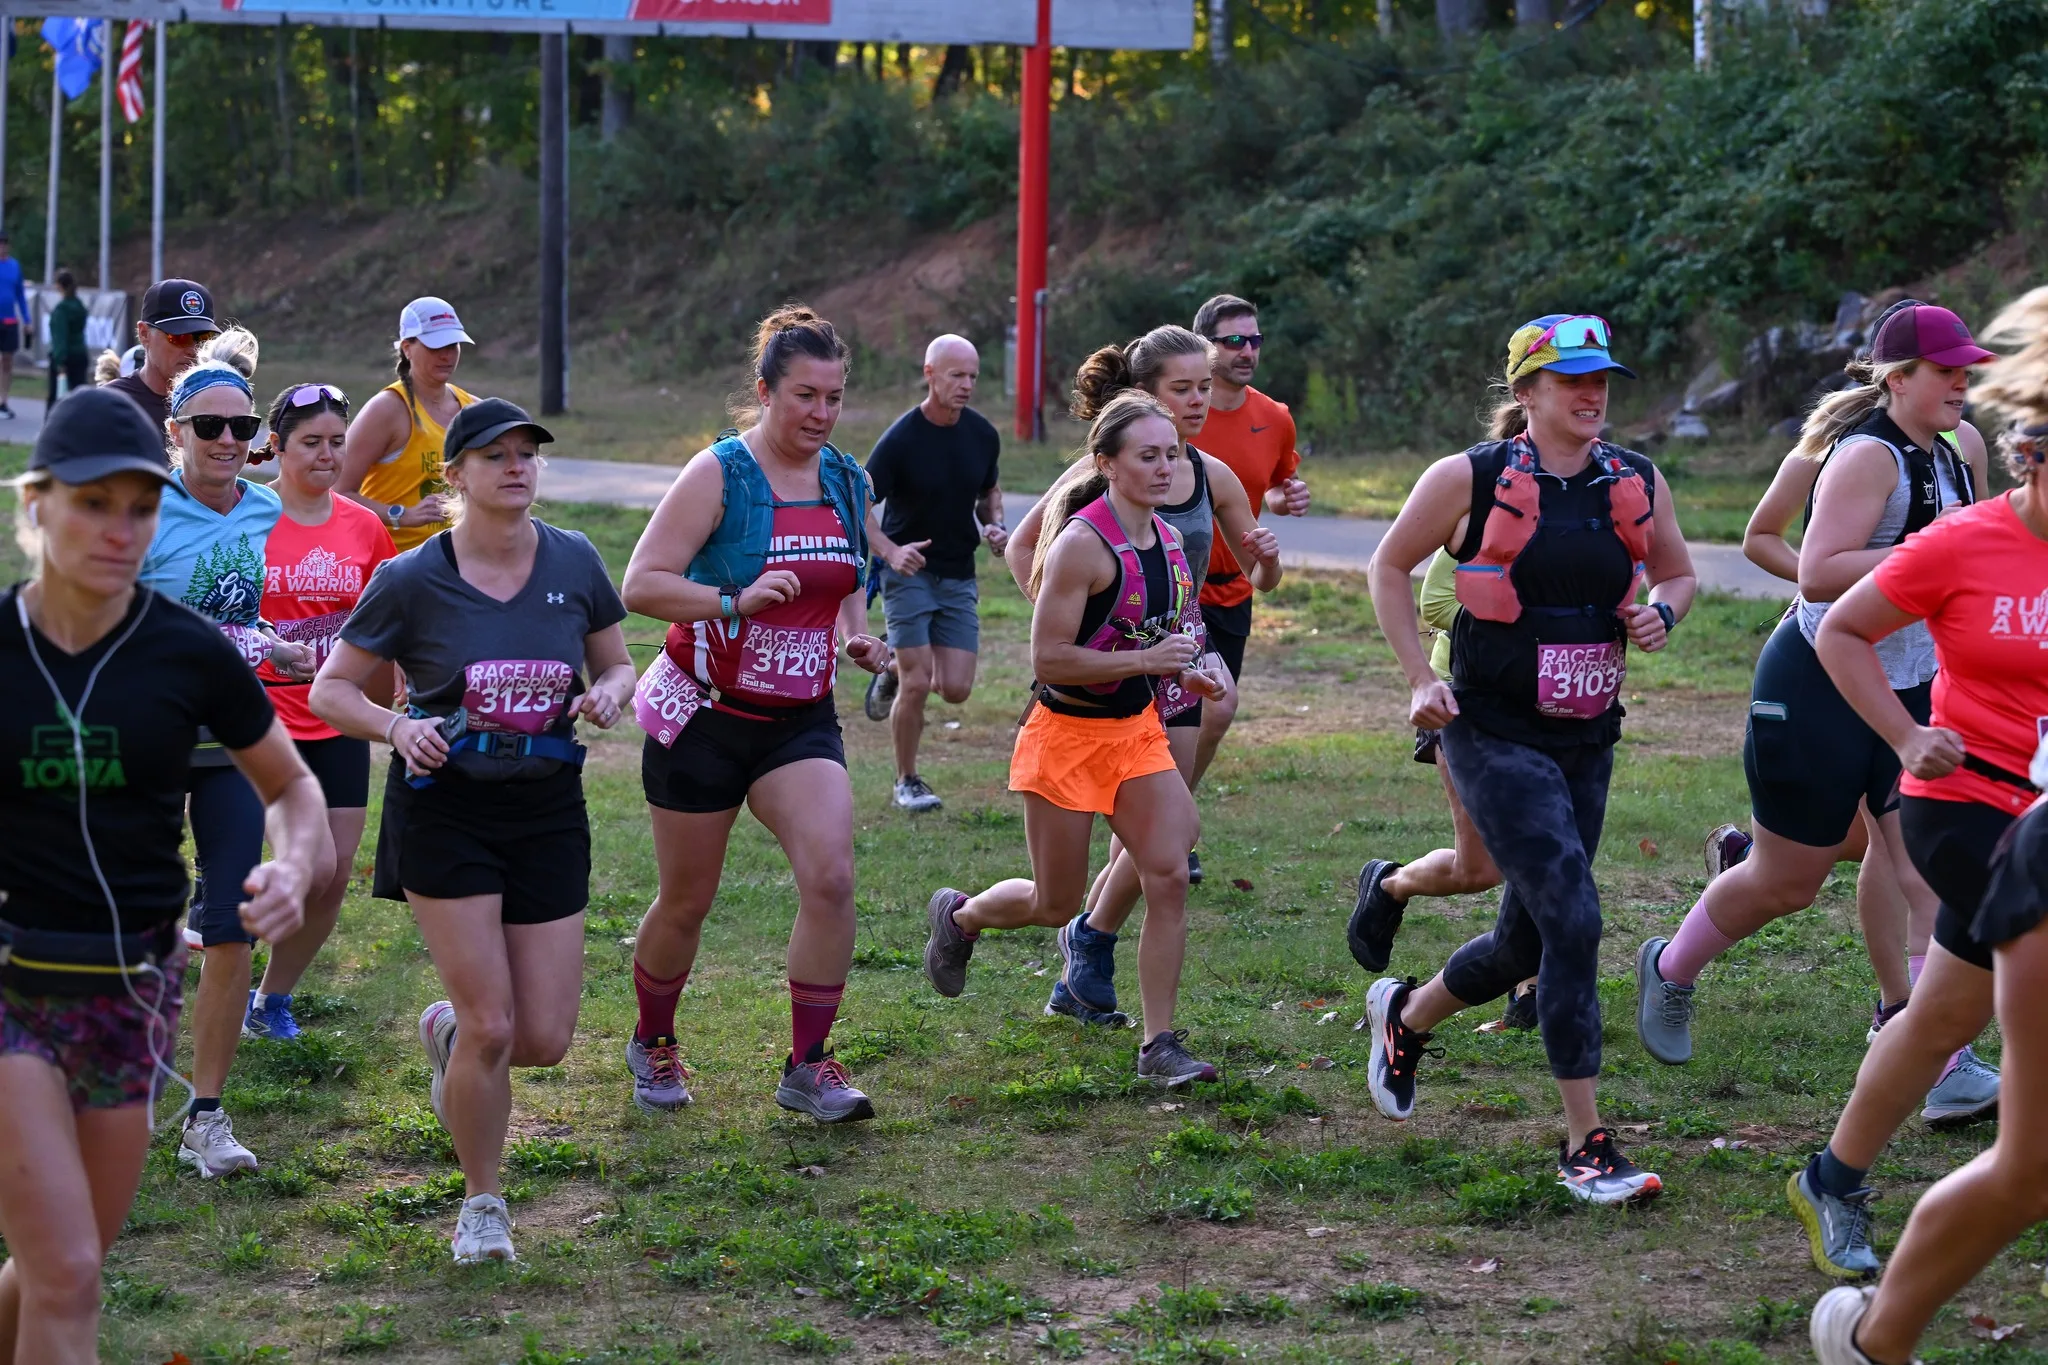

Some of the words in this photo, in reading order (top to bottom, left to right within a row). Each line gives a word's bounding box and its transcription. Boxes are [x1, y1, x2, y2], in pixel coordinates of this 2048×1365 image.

[421, 451, 443, 473] NEL
[766, 535, 856, 566] IGHLAN
[268, 564, 316, 581] RUN
[326, 565, 361, 580] LIKE
[266, 580, 280, 593] A
[287, 578, 360, 592] WARRIOR
[1992, 595, 2048, 617] RU
[277, 617, 322, 635] RACE
[291, 624, 341, 643] WARRIO
[1988, 615, 2011, 634] A
[748, 625, 798, 644] RACE
[800, 631, 827, 645] LIKE
[742, 637, 754, 650] A
[761, 640, 828, 657] WARRIOR
[1542, 648, 1596, 665] RACE
[470, 663, 526, 680] RACE
[530, 664, 571, 679] LIKE
[752, 648, 819, 677] 3120
[1538, 663, 1552, 678] A
[1558, 656, 1625, 677] WARRIOR
[465, 678, 480, 692] A
[486, 677, 572, 692] WARRIOR
[741, 677, 759, 687] Trail
[760, 681, 775, 689] Run
[1552, 668, 1618, 699] 3103
[477, 687, 554, 713] 3123
[639, 674, 681, 720] 3120
[19, 757, 128, 788] IOWA
